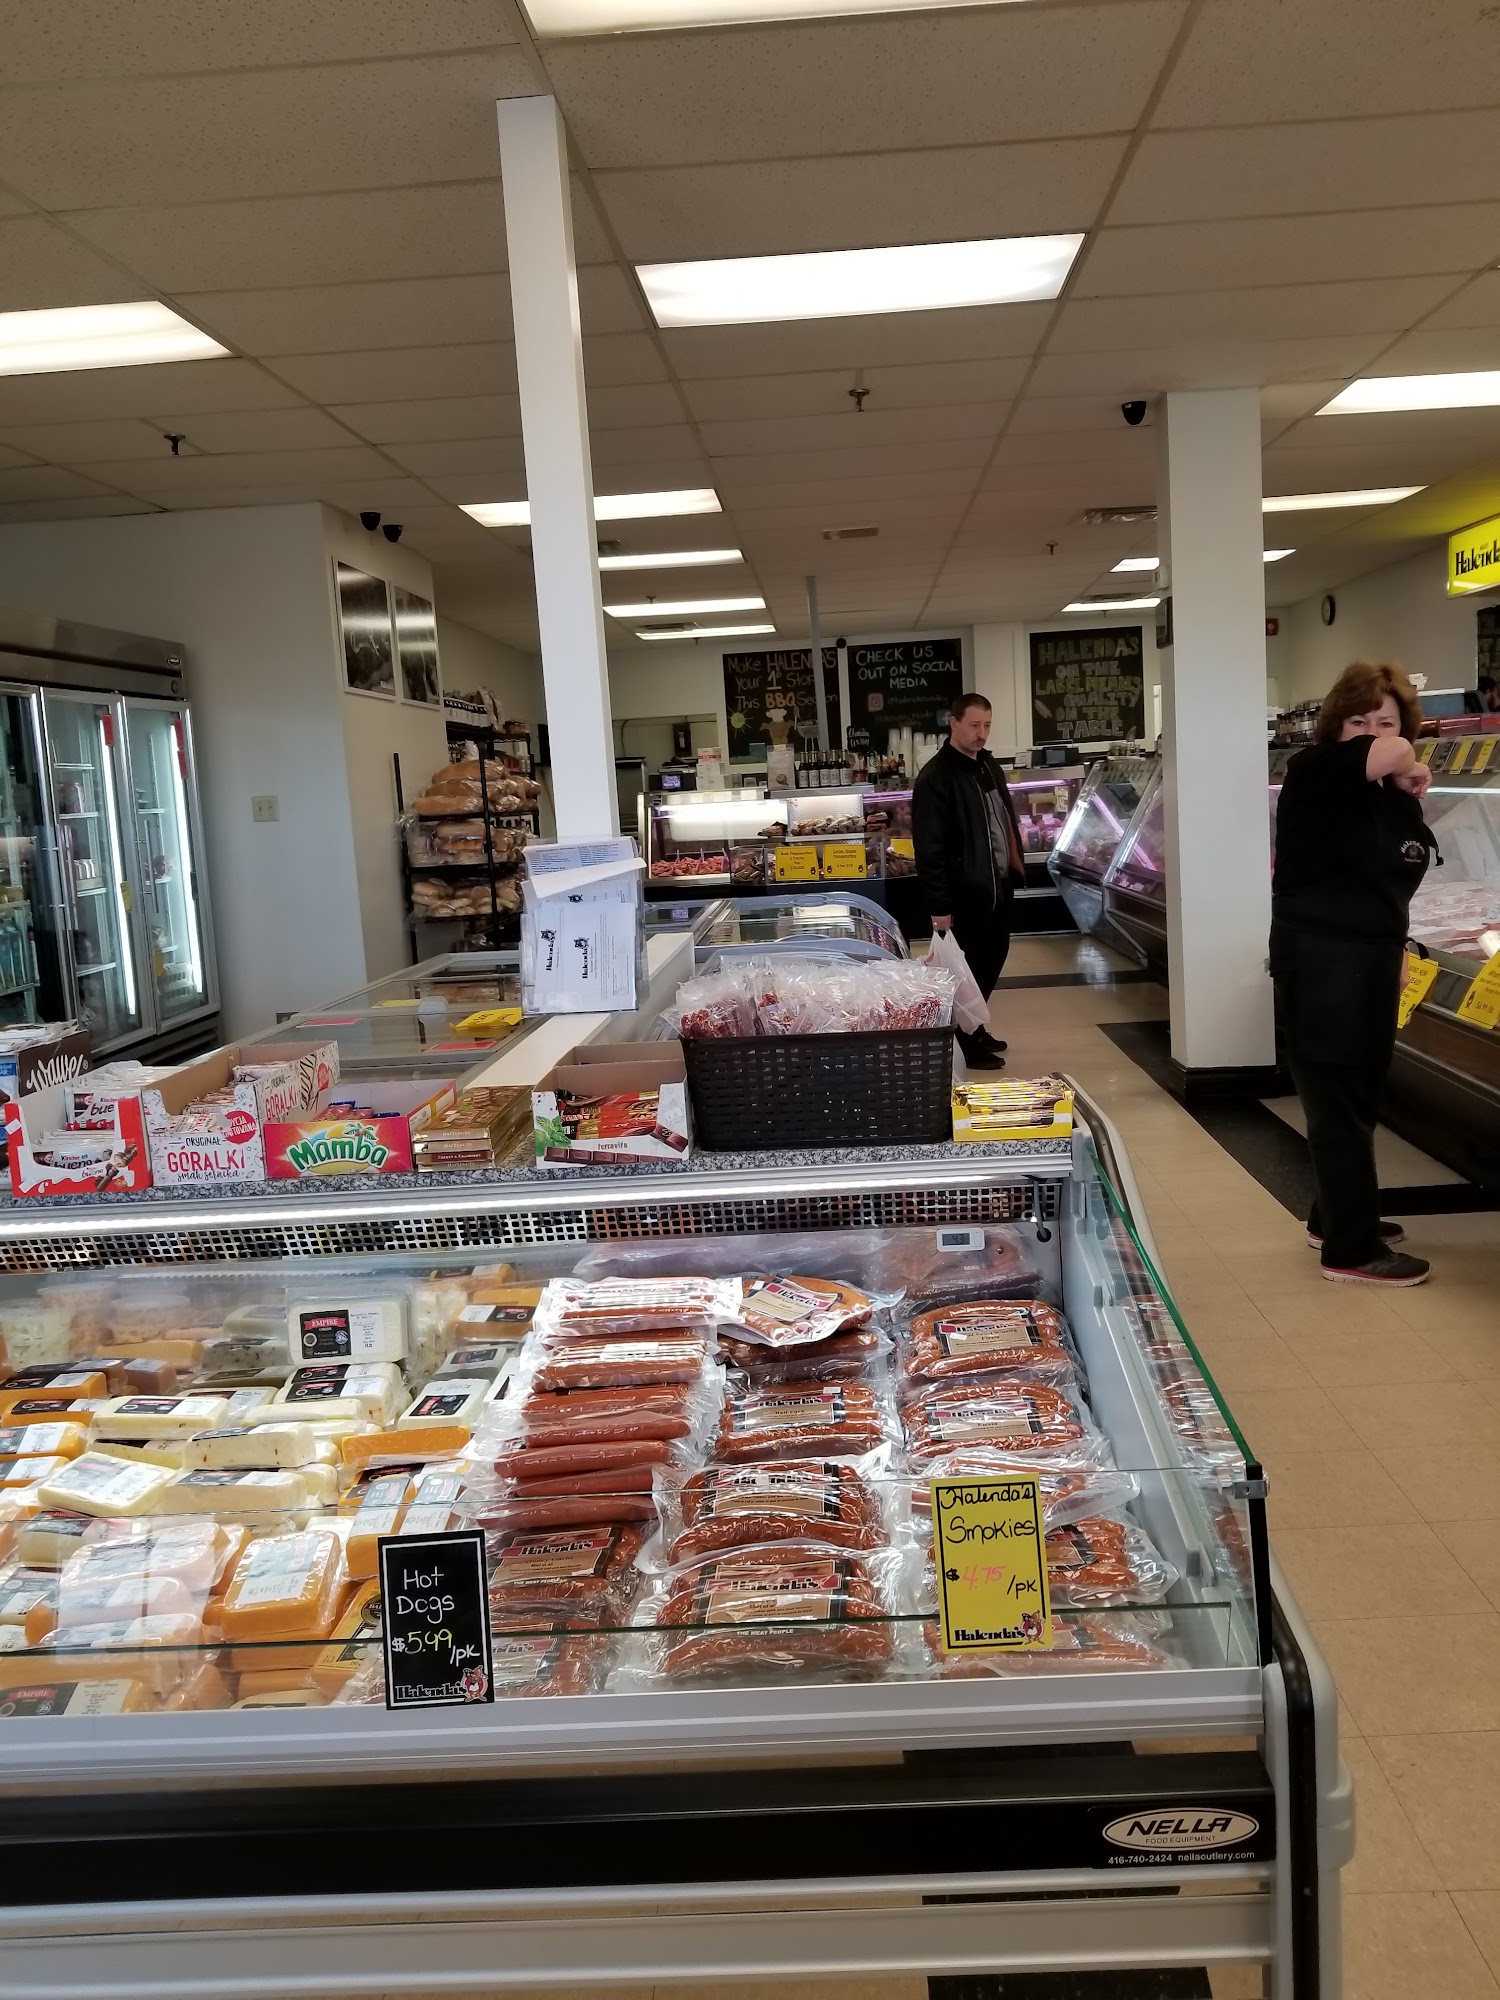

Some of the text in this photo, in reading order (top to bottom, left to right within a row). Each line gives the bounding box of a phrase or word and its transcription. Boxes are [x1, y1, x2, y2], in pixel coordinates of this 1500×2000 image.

[727, 652, 837, 673] Make HALENA'S
[856, 645, 934, 666] CHECK US
[858, 659, 959, 681] OUT ON SOCIAL
[1056, 661, 1121, 679] ON THE
[735, 676, 762, 692] Your
[889, 678, 928, 689] MEDIA
[1036, 676, 1142, 696] LABEL MEANS
[735, 691, 838, 711] This BBQ Seaon
[1064, 691, 1140, 708] QUALITY
[1055, 706, 1121, 721] ON THE
[1057, 720, 1124, 739] TABLE
[168, 1146, 245, 1173] GÓRALKI
[287, 1137, 389, 1171] Mamba
[312, 1319, 338, 1327] EMPIRE
[946, 1516, 1036, 1545] Smokies
[404, 1566, 444, 1590] Hot
[396, 1595, 455, 1624] Dogs
[17, 1689, 49, 1698] EMPIRE
[1126, 1817, 1234, 1836] NELLA
[1170, 1835, 1216, 1843] EQUIPMENT
[1108, 1851, 1255, 1865] 416-740-2424 nellacutlery.com
